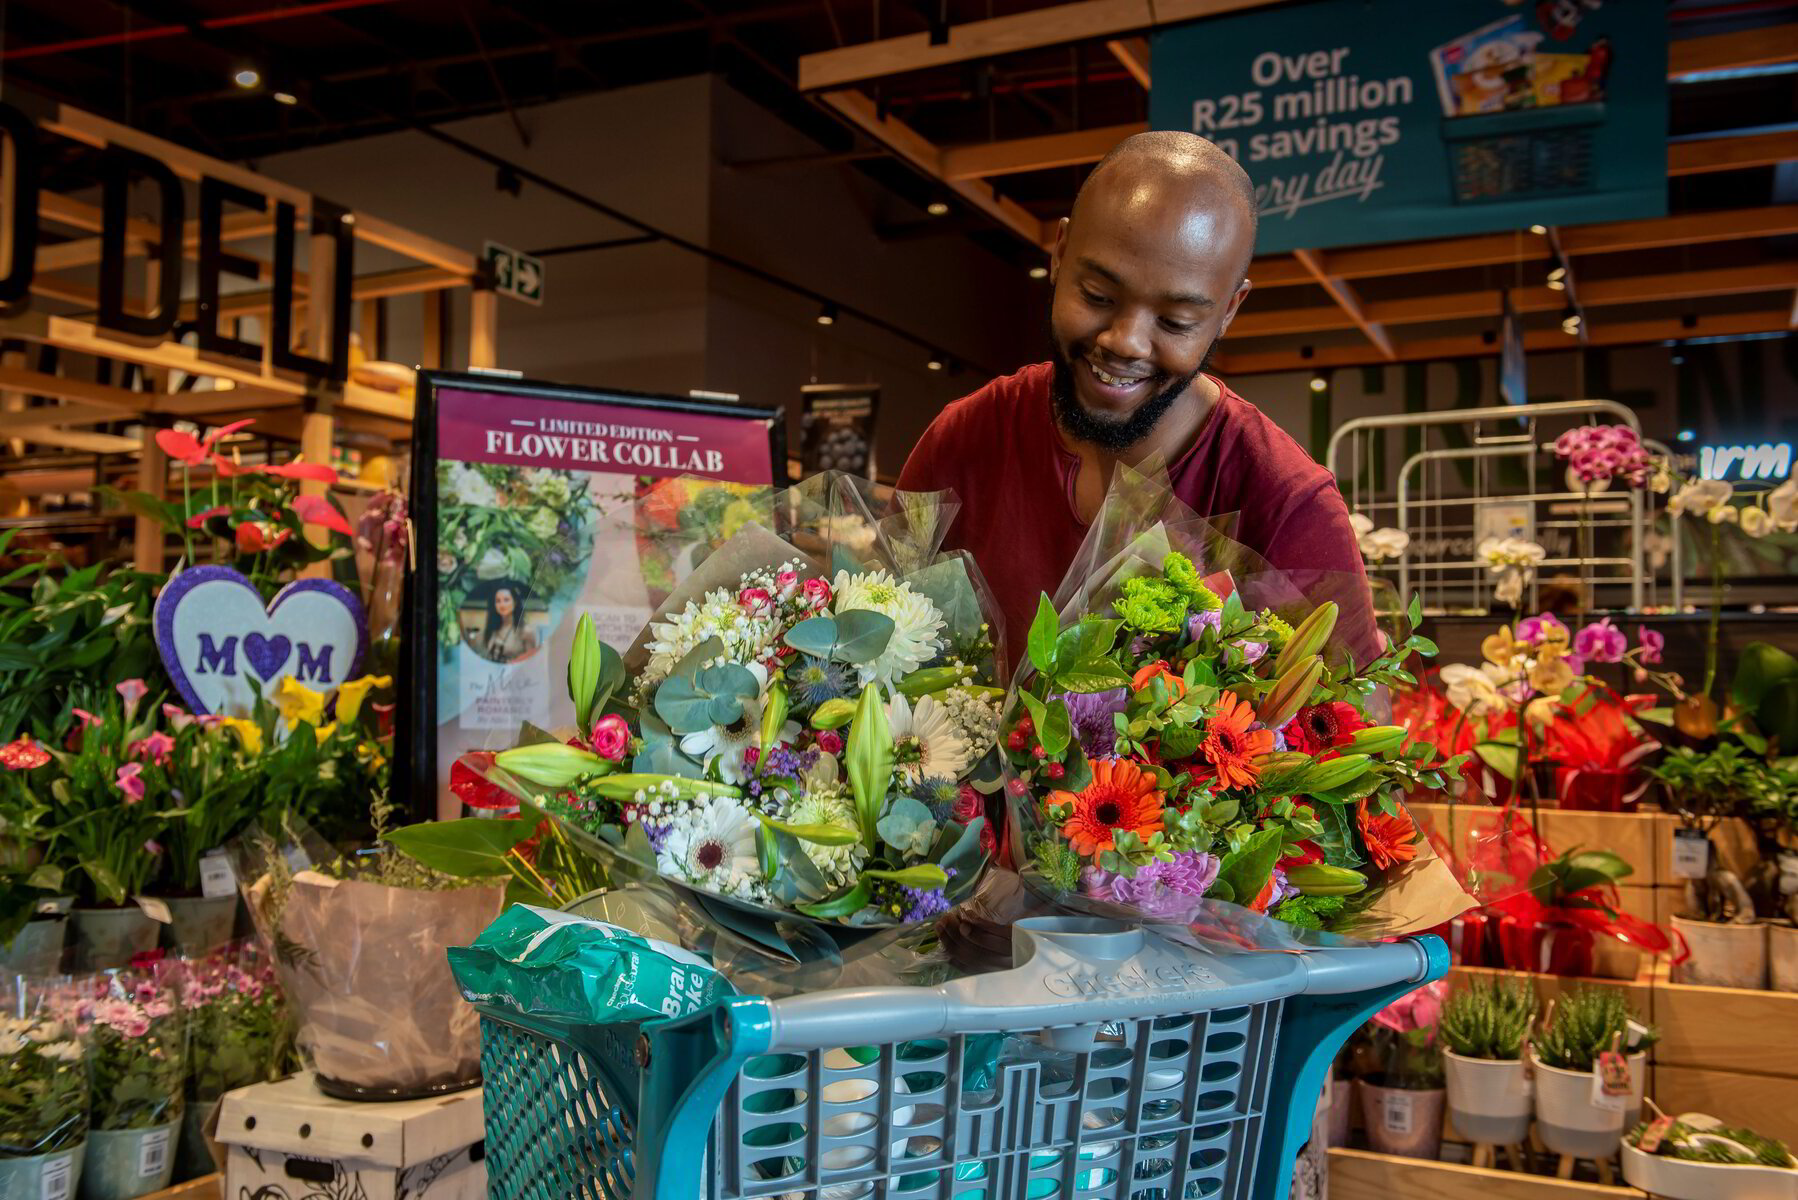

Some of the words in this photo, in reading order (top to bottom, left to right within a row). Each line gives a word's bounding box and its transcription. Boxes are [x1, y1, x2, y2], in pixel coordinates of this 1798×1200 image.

[1251, 47, 1350, 87] Over
[1192, 91, 1264, 132] R25
[1273, 75, 1413, 121] million
[1250, 115, 1401, 162] savings
[1254, 173, 1309, 220] ery
[1313, 151, 1385, 203] day
[98, 145, 354, 380] DELI
[485, 430, 610, 463] FLOWER
[613, 441, 725, 473] COLLAB
[539, 417, 607, 437] LIMITED
[609, 424, 674, 443] EDITION
